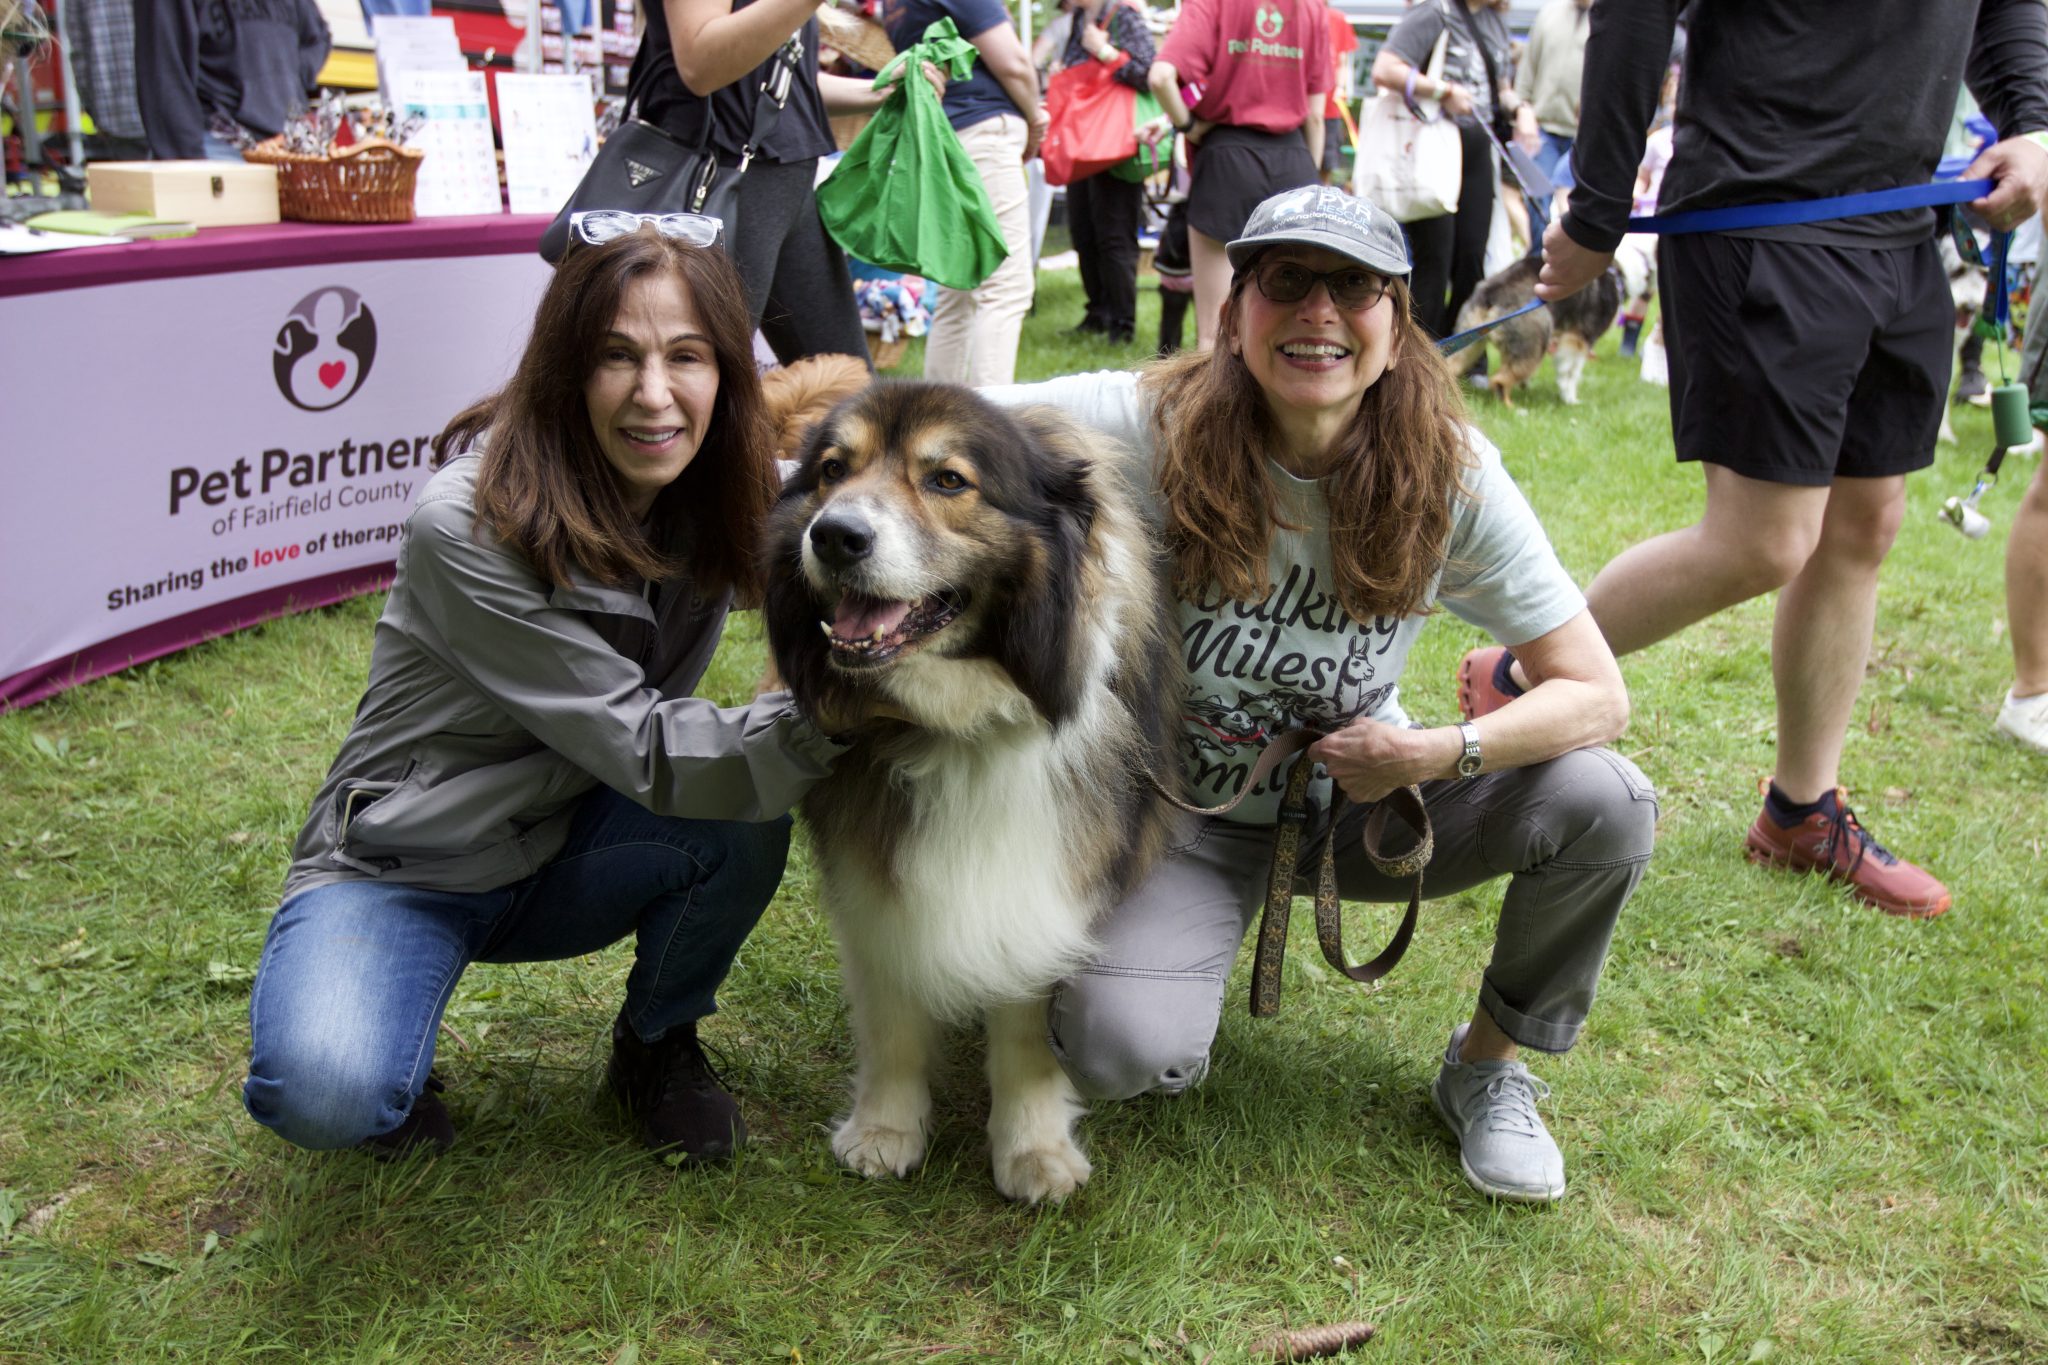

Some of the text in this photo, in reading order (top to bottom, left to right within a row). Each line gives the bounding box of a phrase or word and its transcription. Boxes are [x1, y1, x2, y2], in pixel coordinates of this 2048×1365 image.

[1271, 210, 1369, 236] www.nationalpyr.org
[1315, 203, 1371, 230] RESCUE
[1318, 192, 1372, 221] PYR
[169, 456, 252, 516] Pet
[211, 480, 413, 536] of Fairfield County
[107, 567, 204, 611] Sharing
[210, 556, 248, 579] the
[253, 543, 300, 568] love
[305, 533, 326, 555] of
[1182, 618, 1337, 691] Miles
